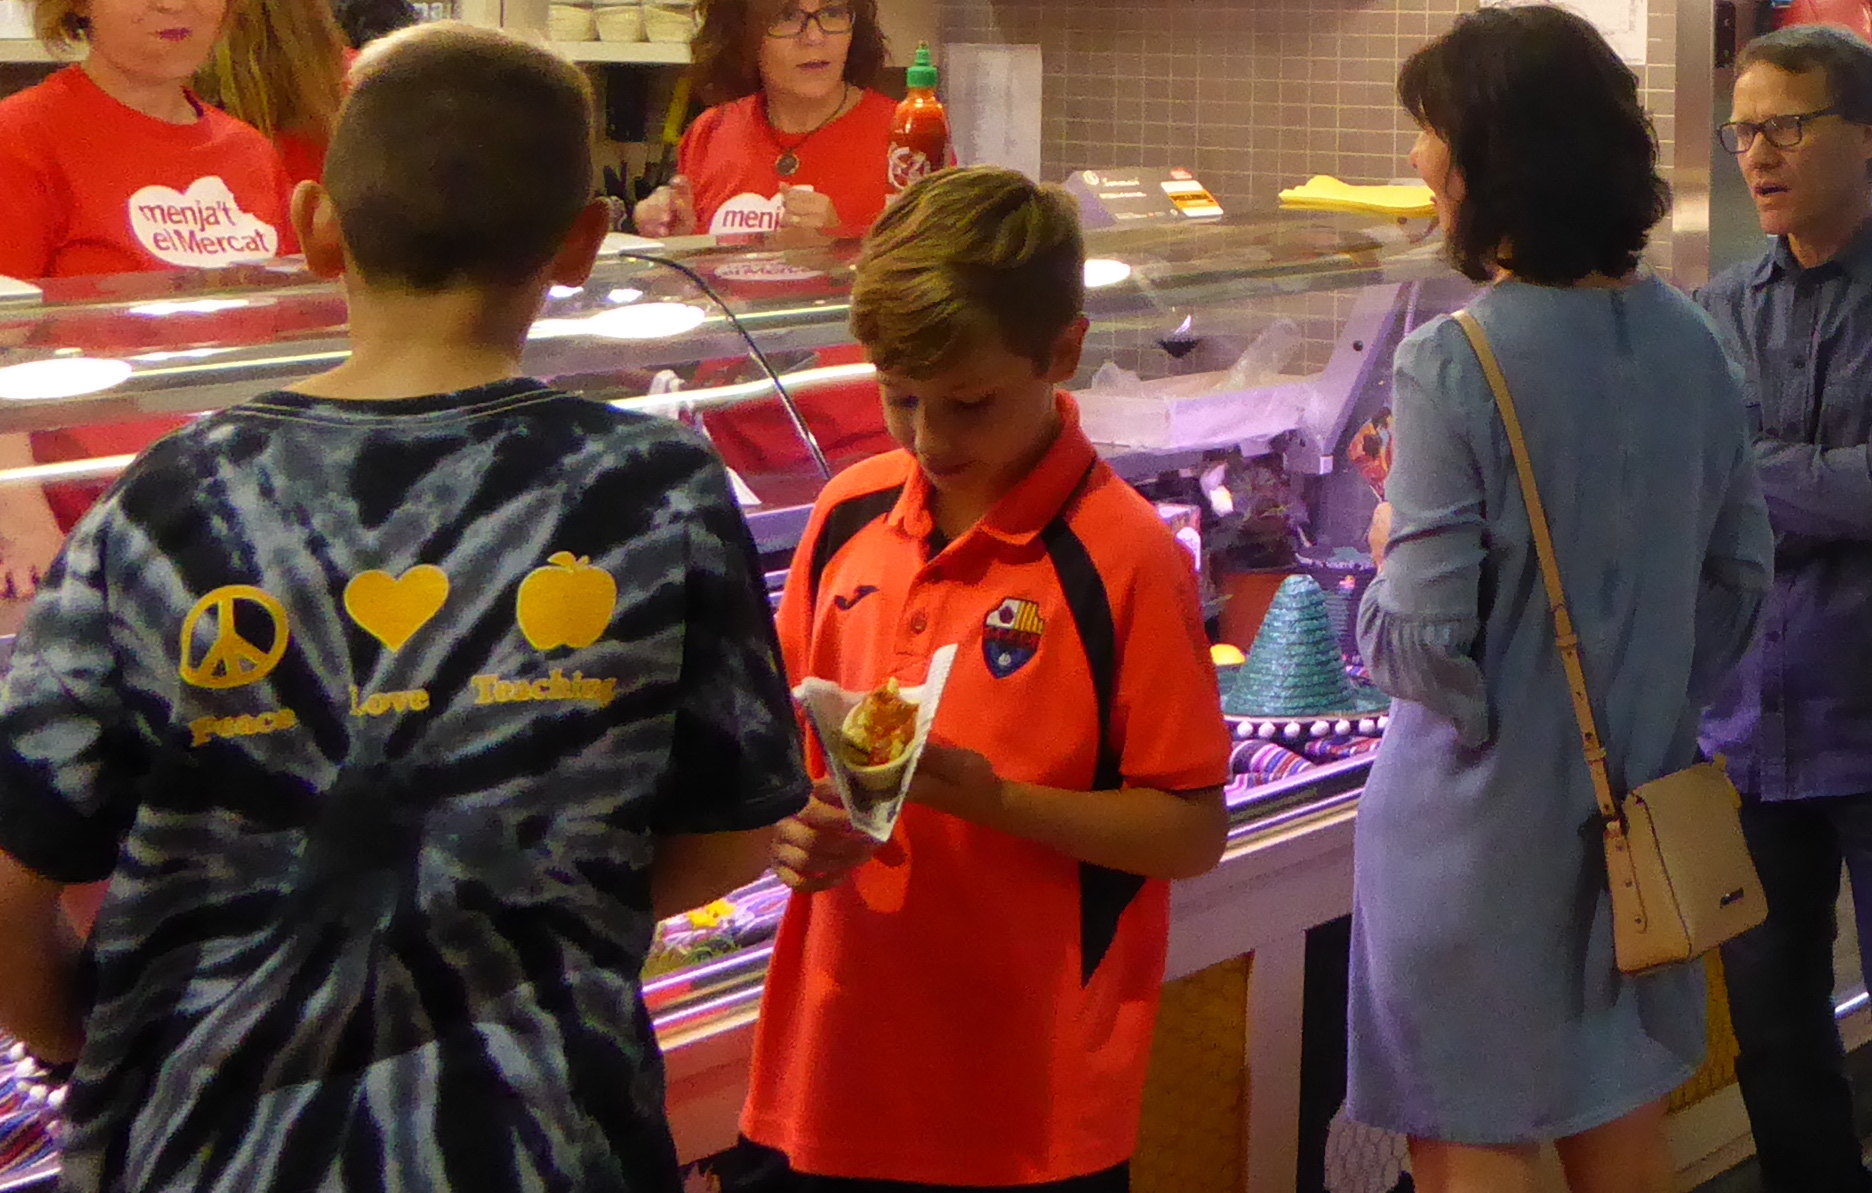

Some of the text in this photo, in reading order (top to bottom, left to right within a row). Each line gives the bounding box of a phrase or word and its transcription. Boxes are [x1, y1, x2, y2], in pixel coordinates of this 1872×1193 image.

[138, 199, 237, 233] menja't
[722, 205, 783, 231] menj
[349, 682, 431, 717] Love
[469, 667, 618, 709] Teaching
[186, 707, 299, 748] Peace
